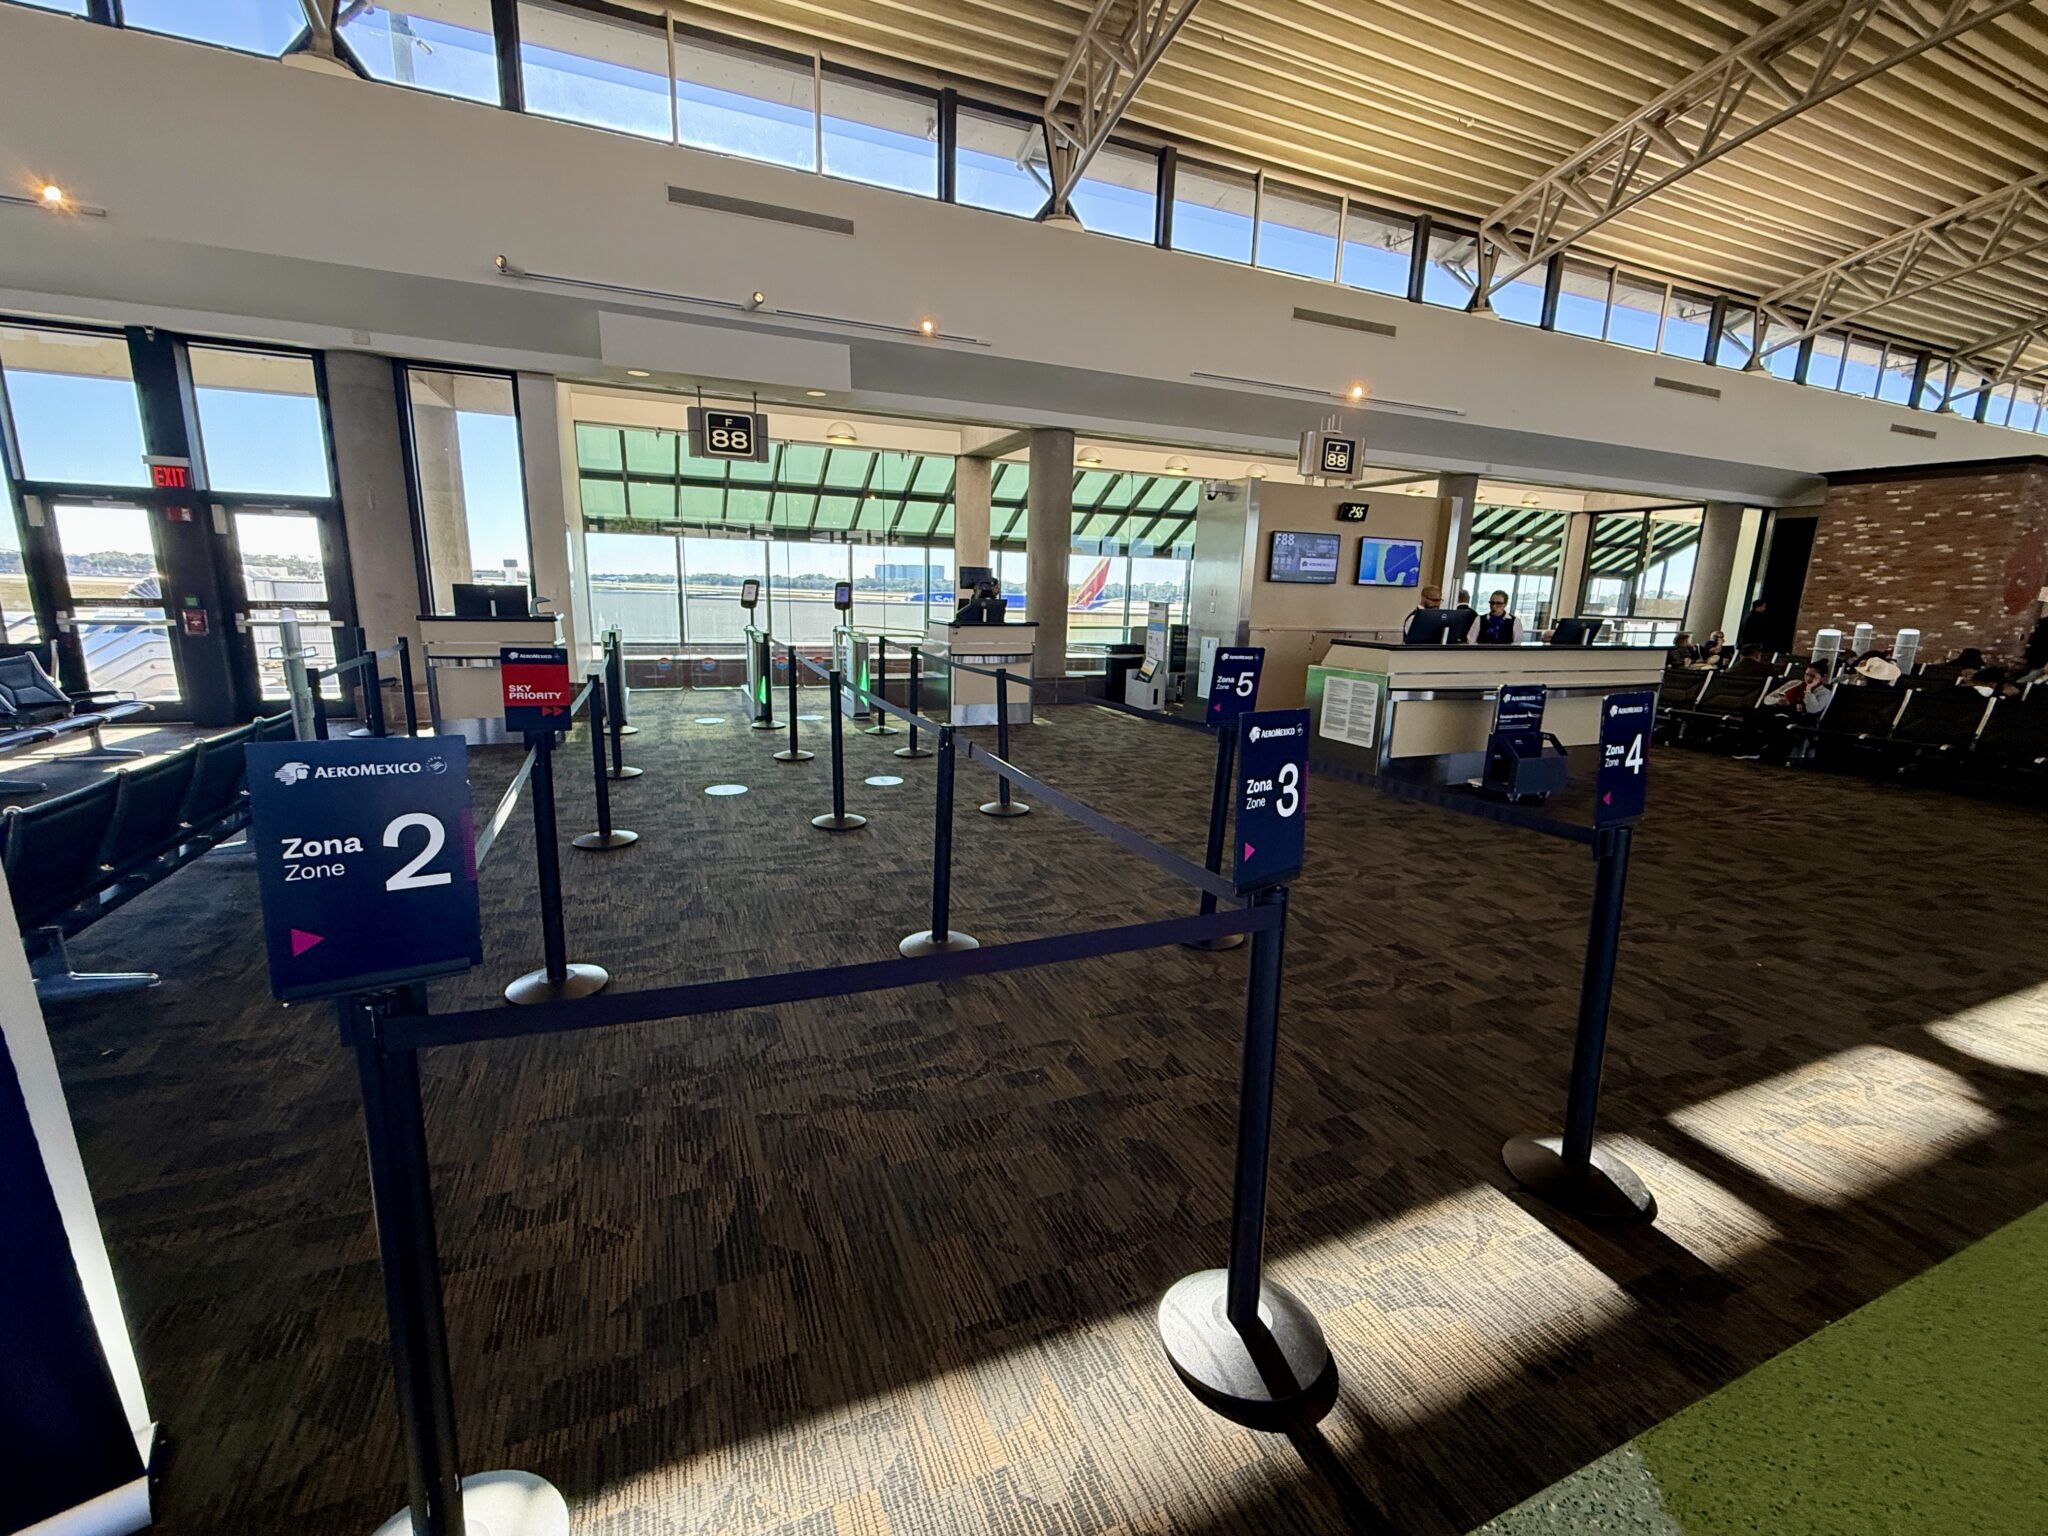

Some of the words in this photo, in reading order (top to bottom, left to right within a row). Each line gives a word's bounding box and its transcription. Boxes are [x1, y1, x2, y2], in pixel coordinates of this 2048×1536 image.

[725, 418, 733, 427] F
[712, 429, 748, 449] 88
[1327, 453, 1346, 467] 88
[153, 466, 185, 488] EXIT
[1275, 533, 1295, 546] F88
[508, 684, 532, 692] SKY
[1216, 675, 1235, 684] Zona
[1235, 671, 1255, 697] 5
[509, 692, 562, 700] PRIORITY
[1605, 744, 1625, 757] Zona
[1625, 733, 1644, 775] 4
[314, 762, 422, 779] AEROMEXICO
[1604, 758, 1620, 768] Zone
[1246, 778, 1273, 795] Zona
[1276, 762, 1299, 818] 3
[1245, 797, 1266, 810] Zone
[281, 836, 364, 860] Zona
[382, 812, 452, 892] 2
[284, 862, 346, 882] Zone
